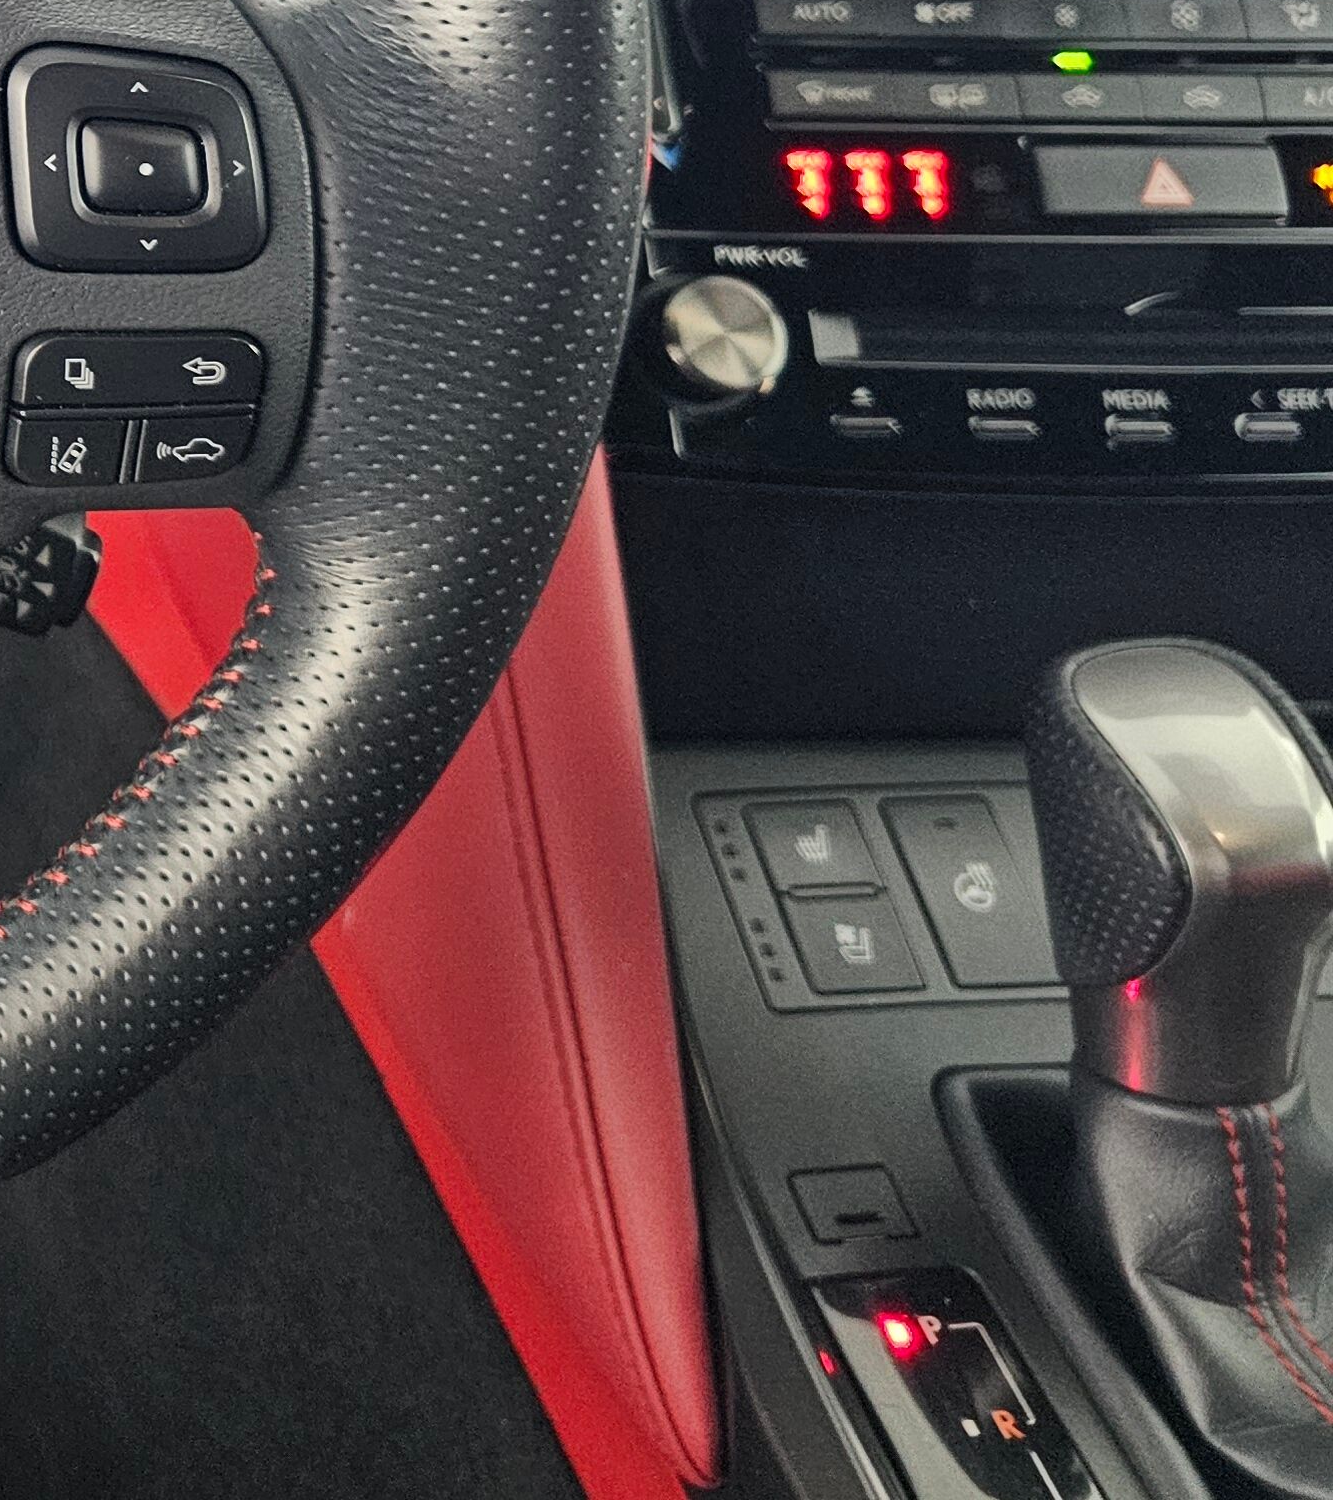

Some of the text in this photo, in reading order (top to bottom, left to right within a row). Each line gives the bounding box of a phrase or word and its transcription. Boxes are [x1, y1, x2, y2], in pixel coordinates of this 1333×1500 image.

[793, 1, 852, 22] AUTO
[967, 388, 1034, 411] RADIO
[1102, 389, 1171, 411] MEDIA
[917, 1314, 943, 1346] P
[991, 1409, 1027, 1441] R
